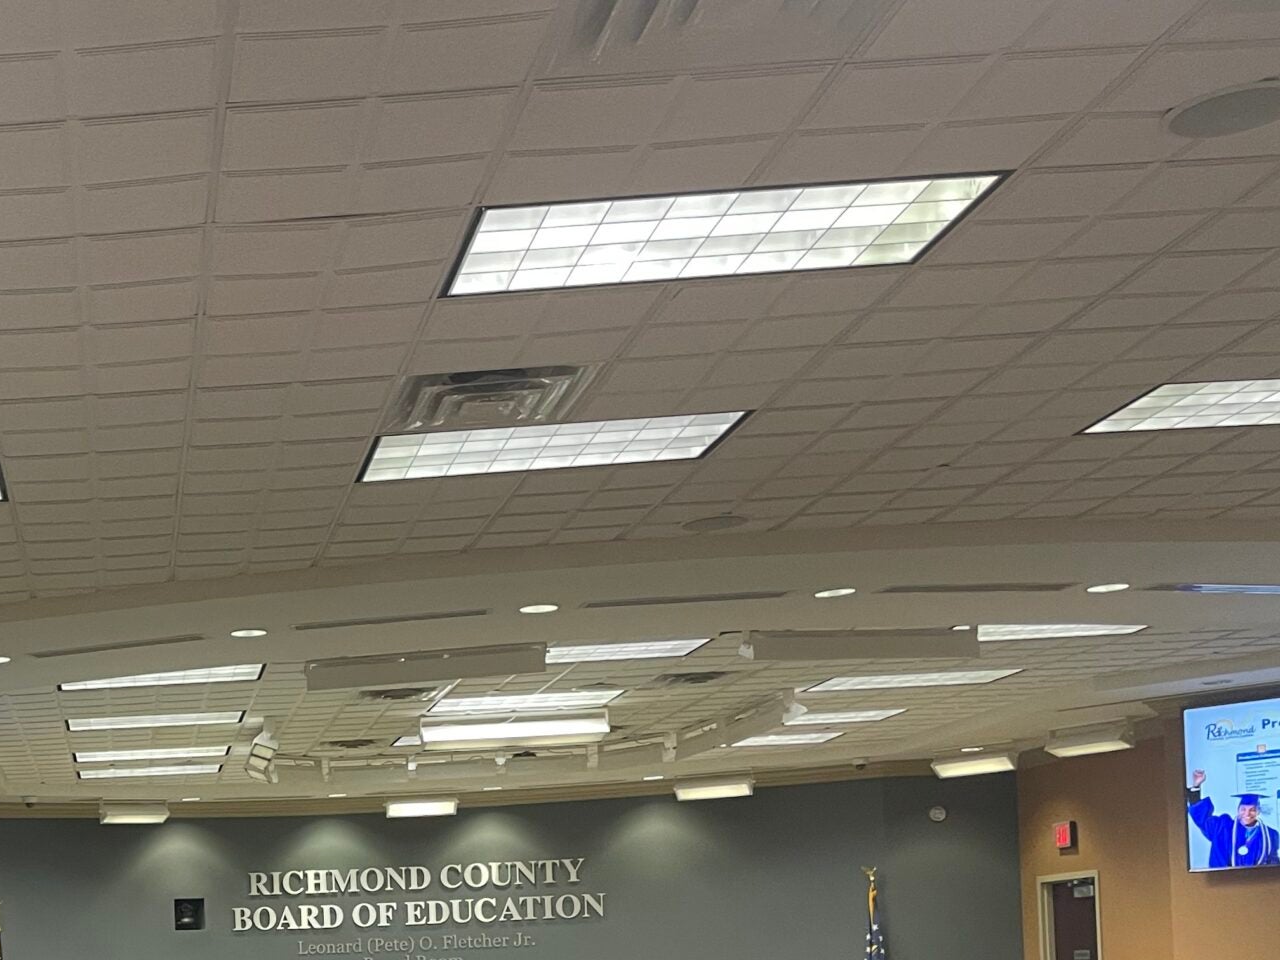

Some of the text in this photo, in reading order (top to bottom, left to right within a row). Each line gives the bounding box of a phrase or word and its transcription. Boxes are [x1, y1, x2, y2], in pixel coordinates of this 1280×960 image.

[1262, 718, 1280, 729] Pr
[248, 857, 585, 896] RICHMOND COUNTY
[231, 892, 606, 931] BOARD OF EDUCATION
[297, 932, 536, 955] Leonard (Pete) O. Fletcher Jr.
